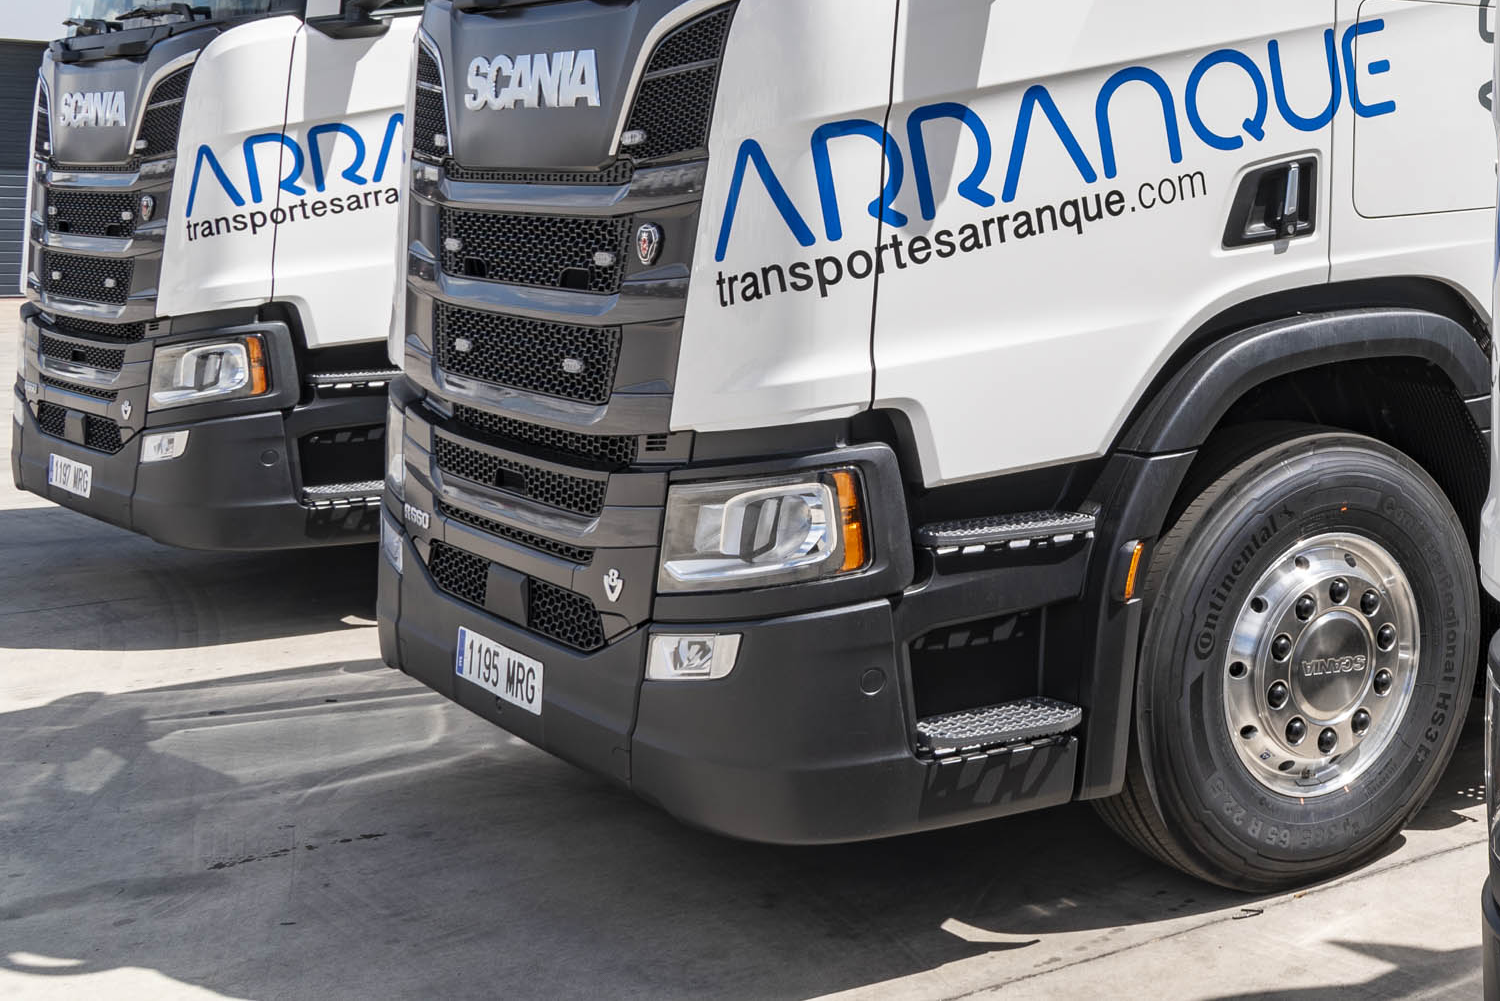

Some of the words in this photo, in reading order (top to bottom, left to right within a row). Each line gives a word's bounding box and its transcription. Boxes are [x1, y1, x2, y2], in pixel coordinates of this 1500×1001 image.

[60, 90, 127, 128] SCANIA
[464, 48, 601, 112] SCANIA
[714, 18, 1397, 262] ARRANQUE
[715, 166, 1209, 308] transportesarranque.com
[54, 459, 72, 485] 1197
[73, 465, 89, 493] MRG
[468, 638, 500, 688] 1195
[505, 657, 536, 705] MRG
[1301, 654, 1367, 677] SCANIA
